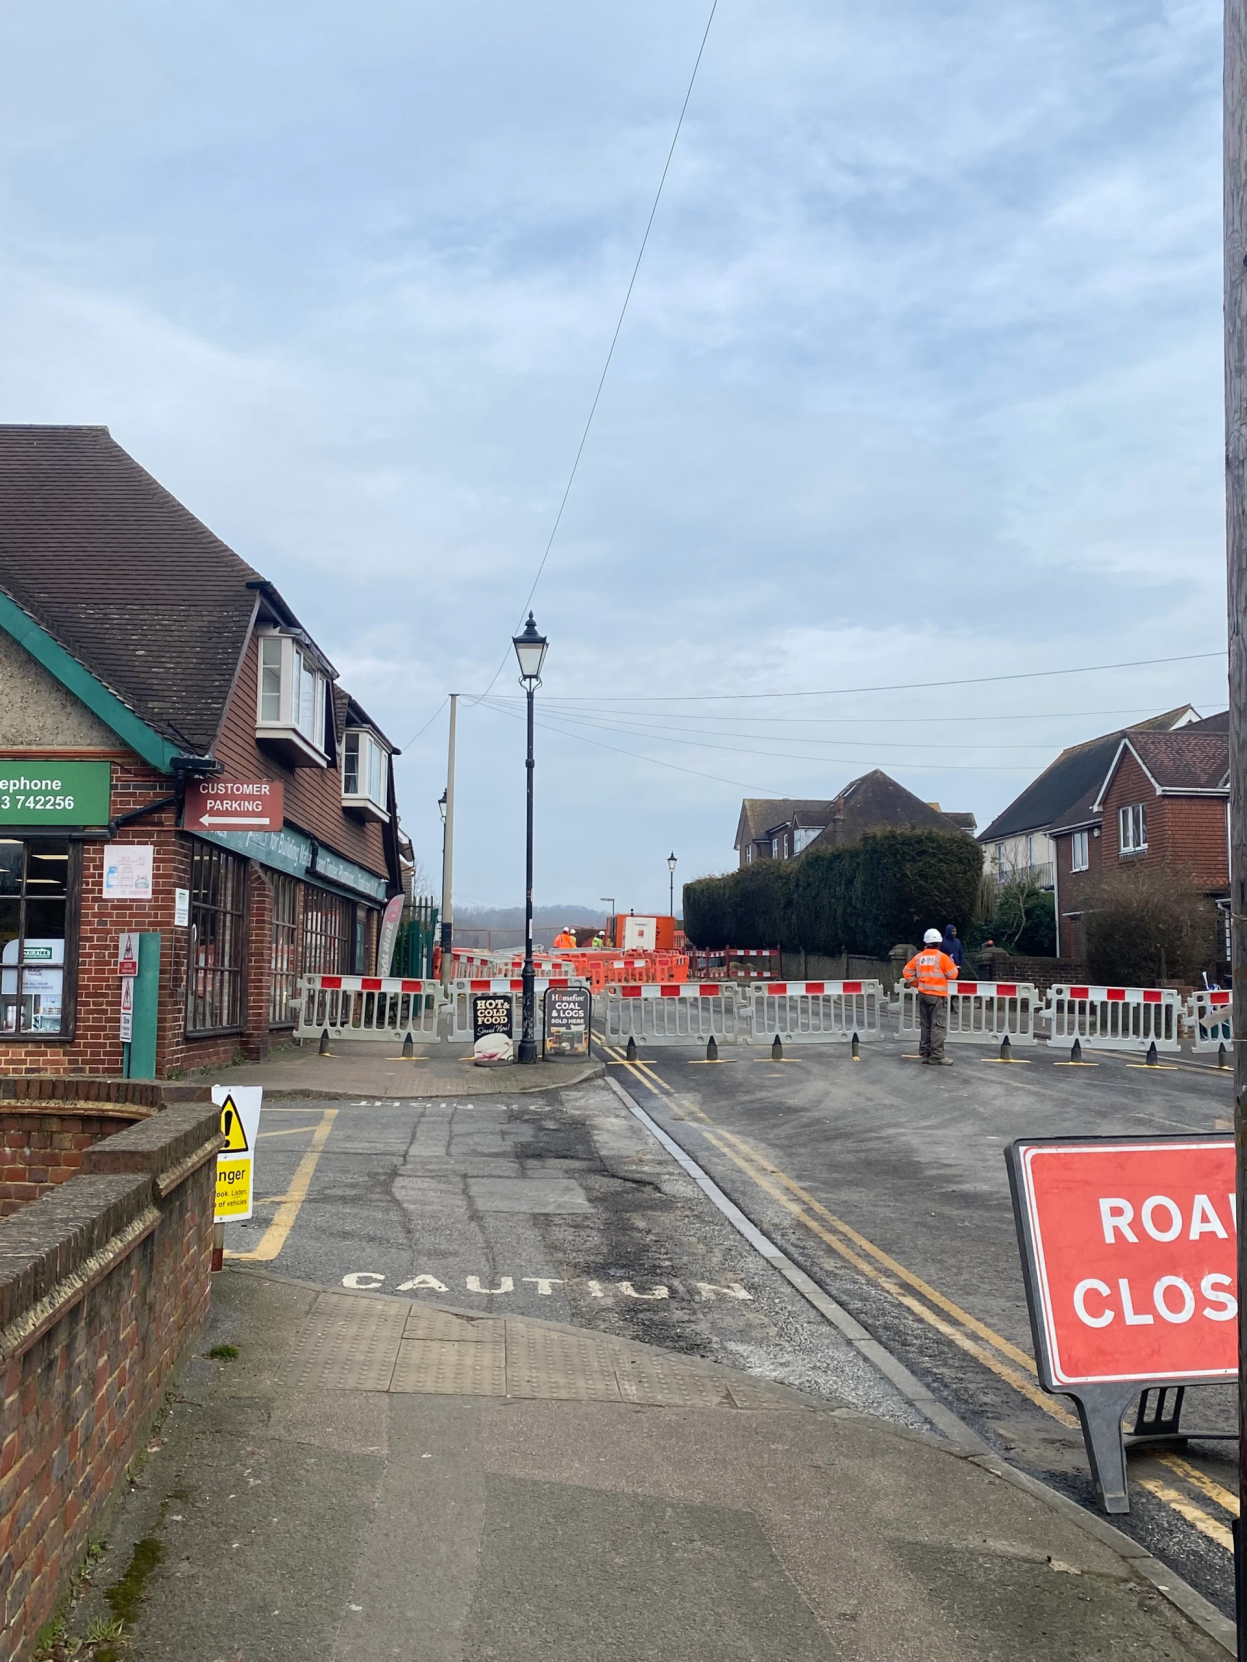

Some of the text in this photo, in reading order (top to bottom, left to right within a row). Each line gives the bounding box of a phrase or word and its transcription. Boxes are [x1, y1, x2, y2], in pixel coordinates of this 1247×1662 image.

[199, 782, 270, 796] CUSTOMER
[15, 795, 75, 810] 742256
[206, 799, 263, 812] PARKING
[278, 833, 300, 867] Building
[382, 921, 394, 953] HIRE
[551, 993, 586, 1003] Homefire
[555, 1002, 581, 1010] COAL
[477, 1009, 507, 1017] COLD
[551, 1010, 585, 1018] & LOGS
[477, 1017, 508, 1025] FOOD
[216, 1169, 246, 1185] nger
[218, 1200, 225, 1208] of
[227, 1198, 248, 1207] vehicles
